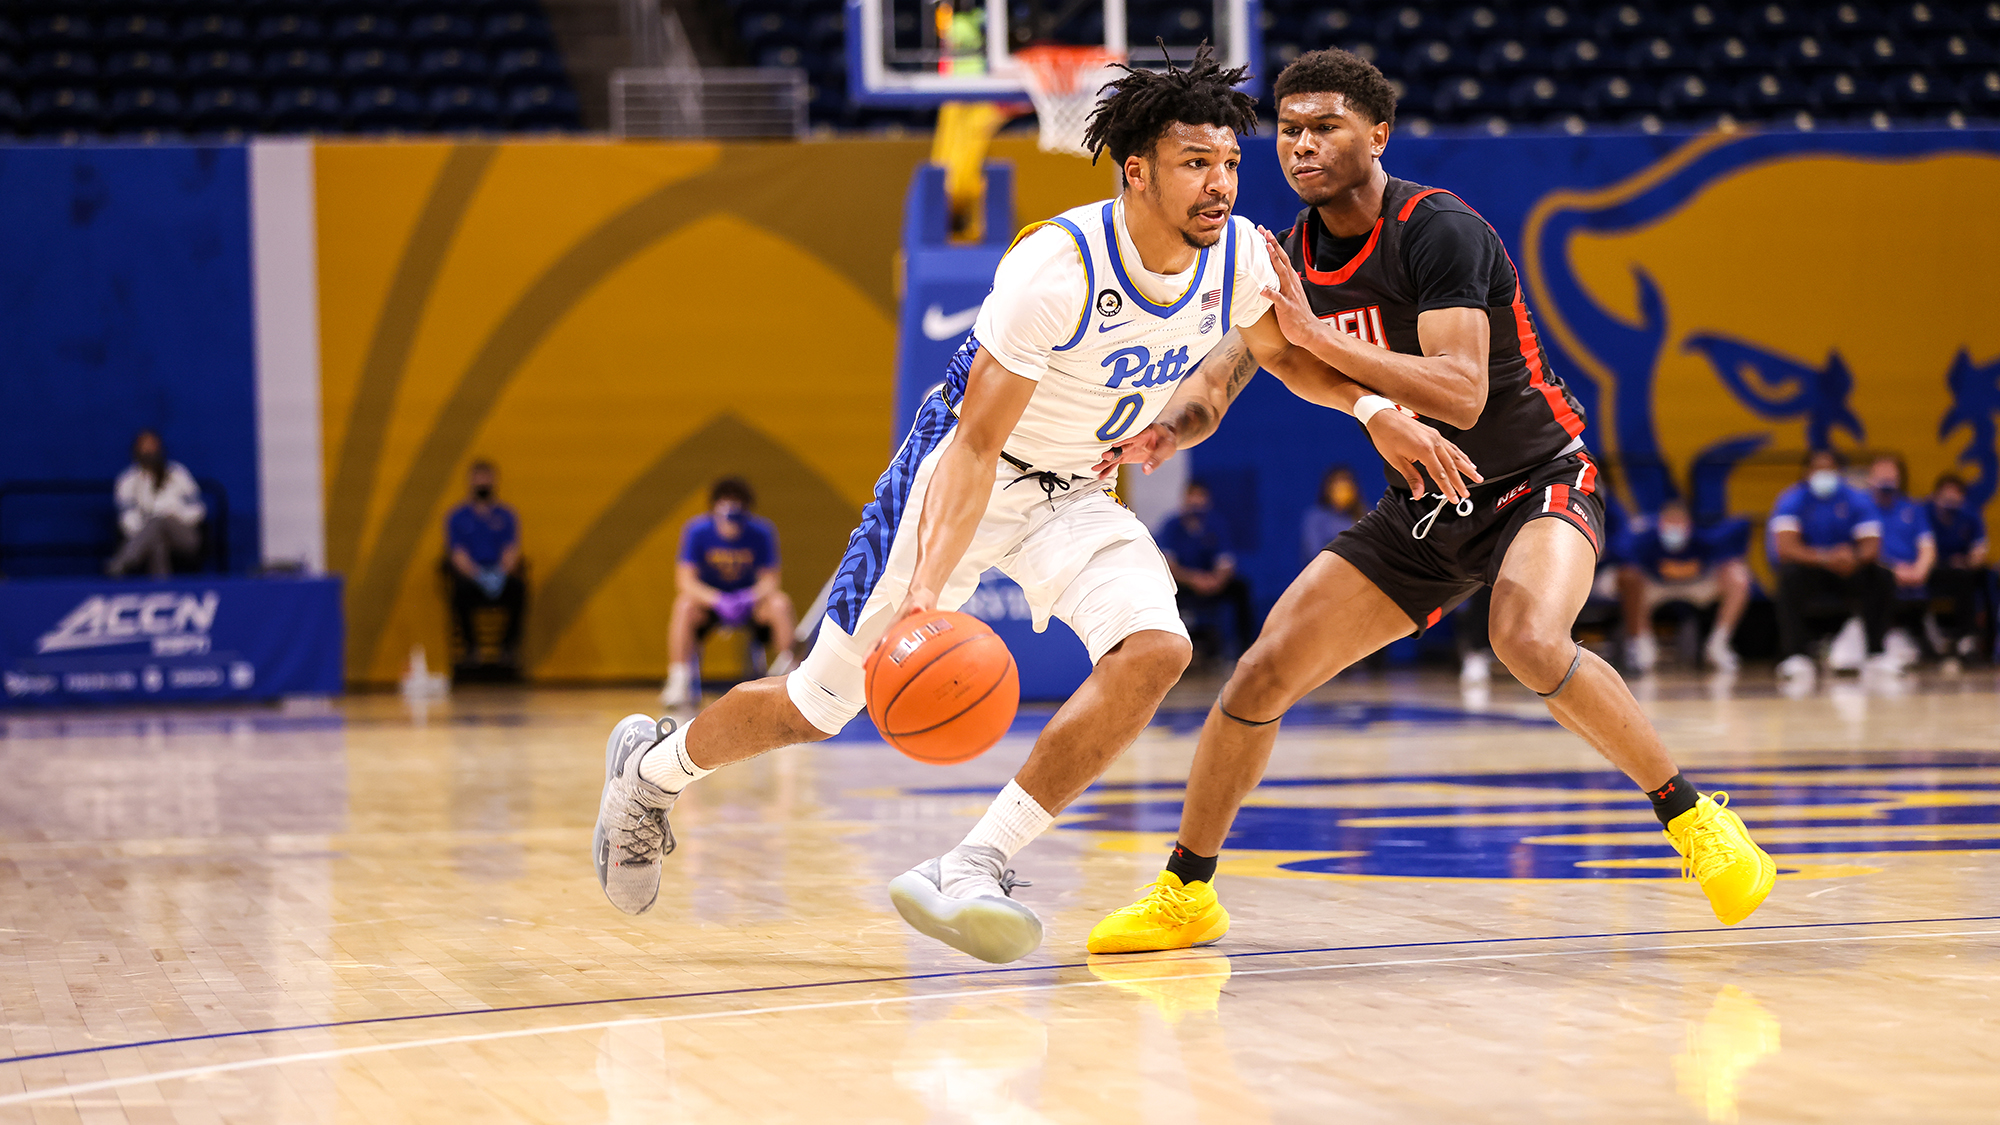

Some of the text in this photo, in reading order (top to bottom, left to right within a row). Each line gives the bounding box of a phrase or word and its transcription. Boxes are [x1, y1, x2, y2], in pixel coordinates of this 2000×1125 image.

[1100, 345, 1190, 389] Pitt
[1095, 391, 1145, 442] 0
[1496, 479, 1530, 508] NEC
[36, 590, 220, 653] ACCN
